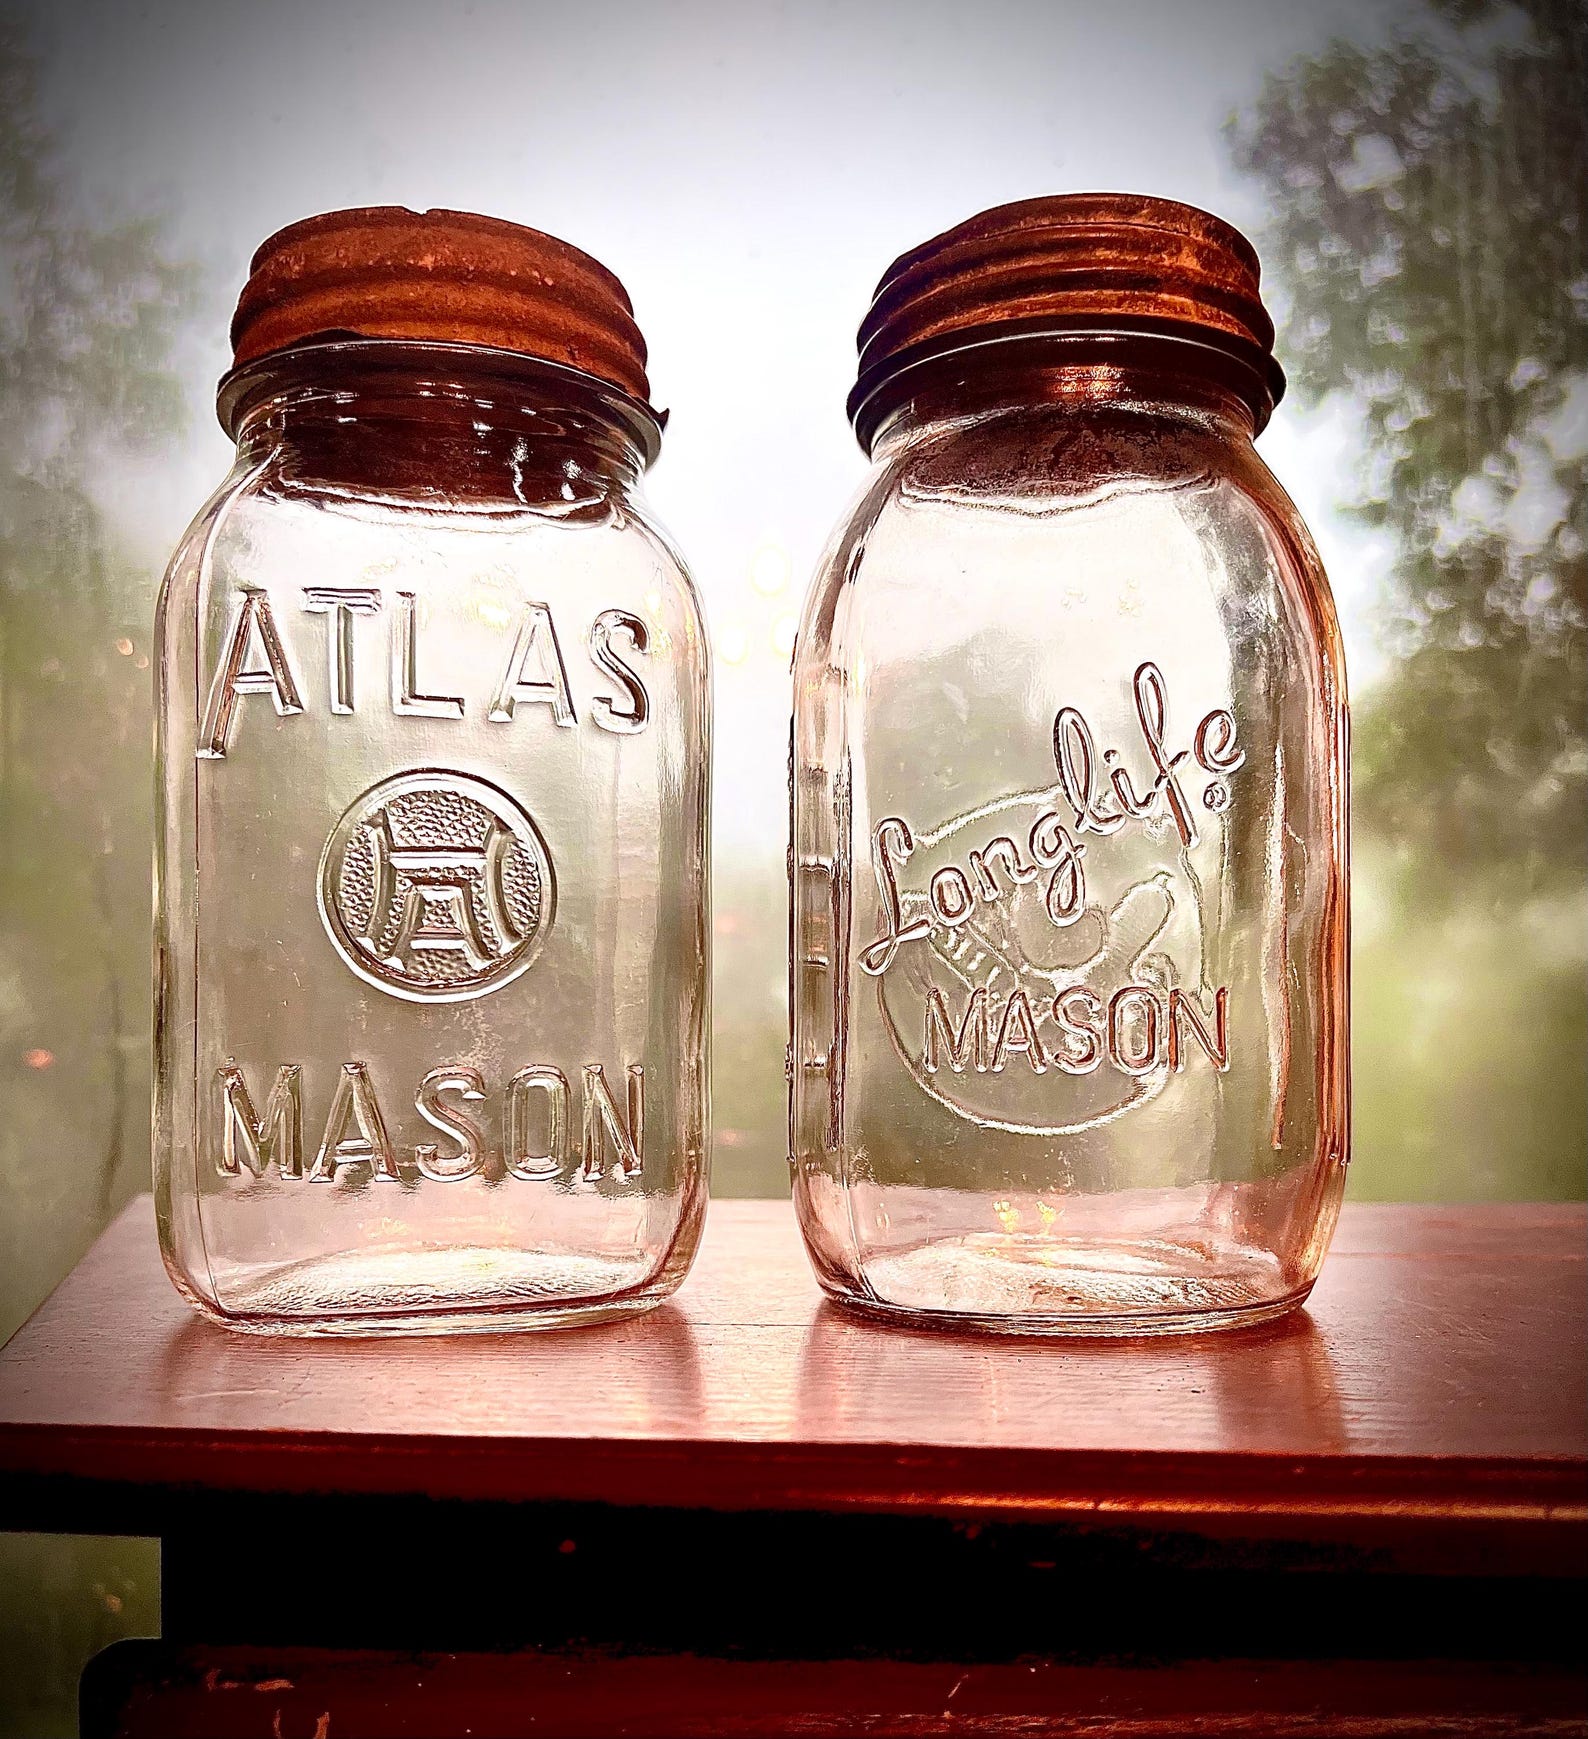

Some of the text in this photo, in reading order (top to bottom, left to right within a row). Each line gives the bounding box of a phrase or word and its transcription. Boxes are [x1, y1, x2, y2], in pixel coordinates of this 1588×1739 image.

[197, 586, 652, 760] ATLAS
[923, 986, 1231, 1076] MASON
[215, 1061, 643, 1182] MASON
